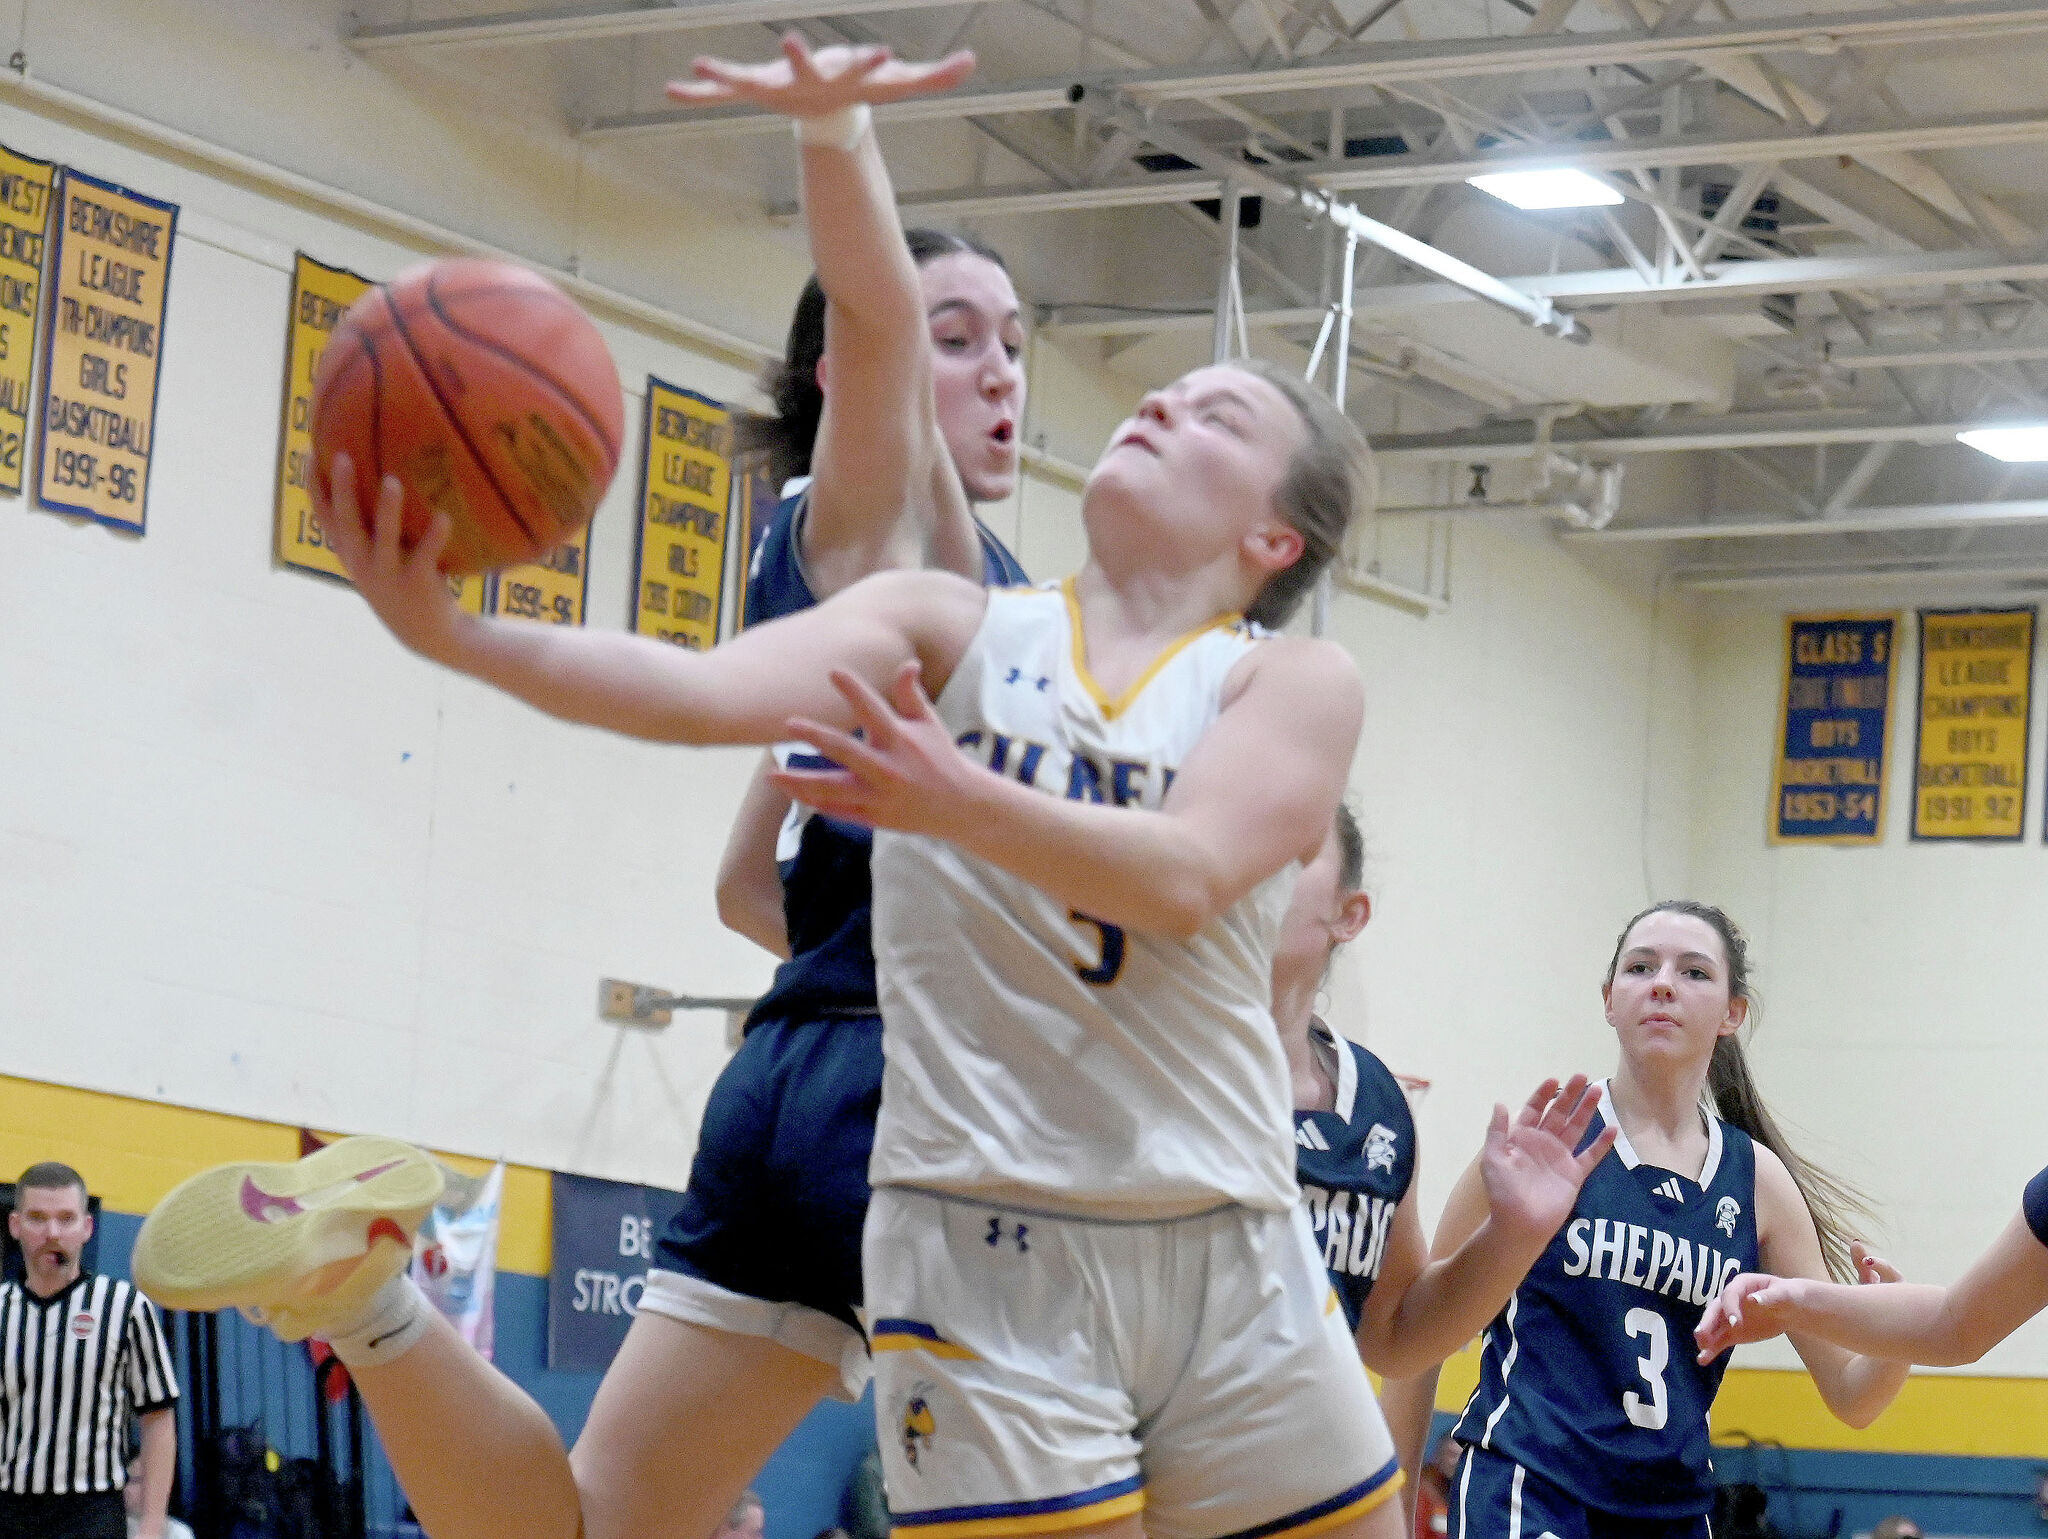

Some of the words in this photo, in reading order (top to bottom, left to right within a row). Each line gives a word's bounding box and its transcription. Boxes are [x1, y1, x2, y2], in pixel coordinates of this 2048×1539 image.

[70, 194, 162, 261] BERKSHIRE
[80, 249, 145, 305] LEAGUE
[80, 352, 128, 400] GIRLS
[1796, 631, 1862, 665] CLASS
[1622, 1306, 1671, 1431] 3
